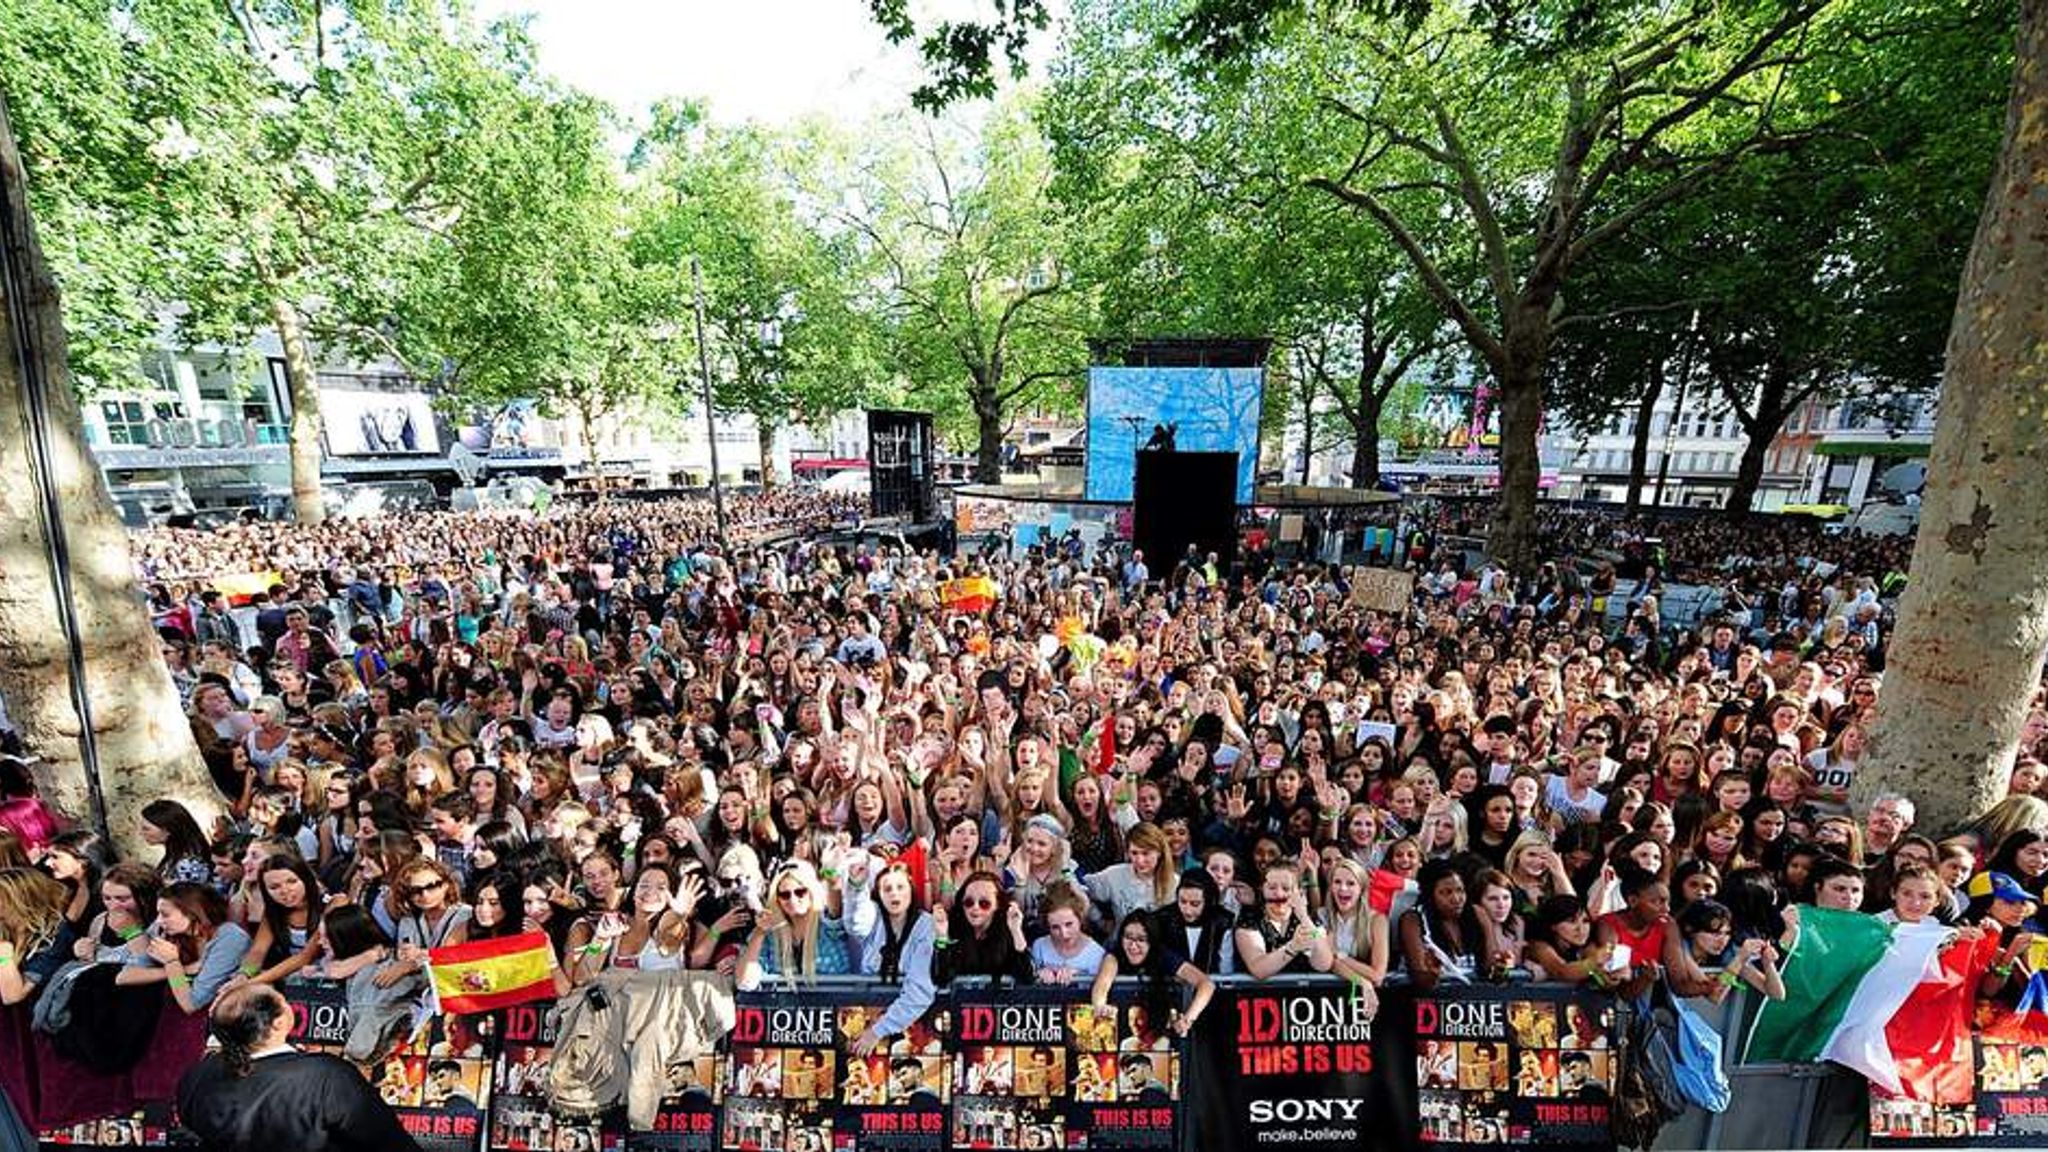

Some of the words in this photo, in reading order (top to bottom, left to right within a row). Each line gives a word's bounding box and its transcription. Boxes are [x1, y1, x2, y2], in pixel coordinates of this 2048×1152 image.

[315, 1006, 349, 1026] ON
[772, 1009, 833, 1031] ONE
[1002, 1007, 1062, 1029] ONE
[1237, 998, 1281, 1042] 1D
[1289, 997, 1370, 1025] ONE
[1445, 1003, 1504, 1025] ONE
[960, 1007, 995, 1040] 1D
[1445, 1023, 1504, 1037] DIRECTION
[313, 1025, 345, 1041] DIREC
[771, 1030, 832, 1044] DIRECTION
[1002, 1028, 1062, 1042] DIRECTION
[1290, 1024, 1371, 1042] DIRECTION
[1238, 1045, 1299, 1075] THIS
[1304, 1045, 1331, 1073] IS
[1336, 1044, 1373, 1073] US
[1093, 1109, 1129, 1127] THIS
[1132, 1109, 1148, 1127] IS
[1151, 1109, 1173, 1127] US
[1249, 1099, 1364, 1123] SONY
[1536, 1104, 1570, 1122] THIS
[433, 1114, 451, 1133] IS
[453, 1115, 477, 1133] US
[691, 1113, 714, 1130] US
[861, 1113, 898, 1130] THIS
[902, 1113, 917, 1130] IS
[921, 1113, 943, 1130] US
[1258, 1128, 1357, 1142] make.believe
